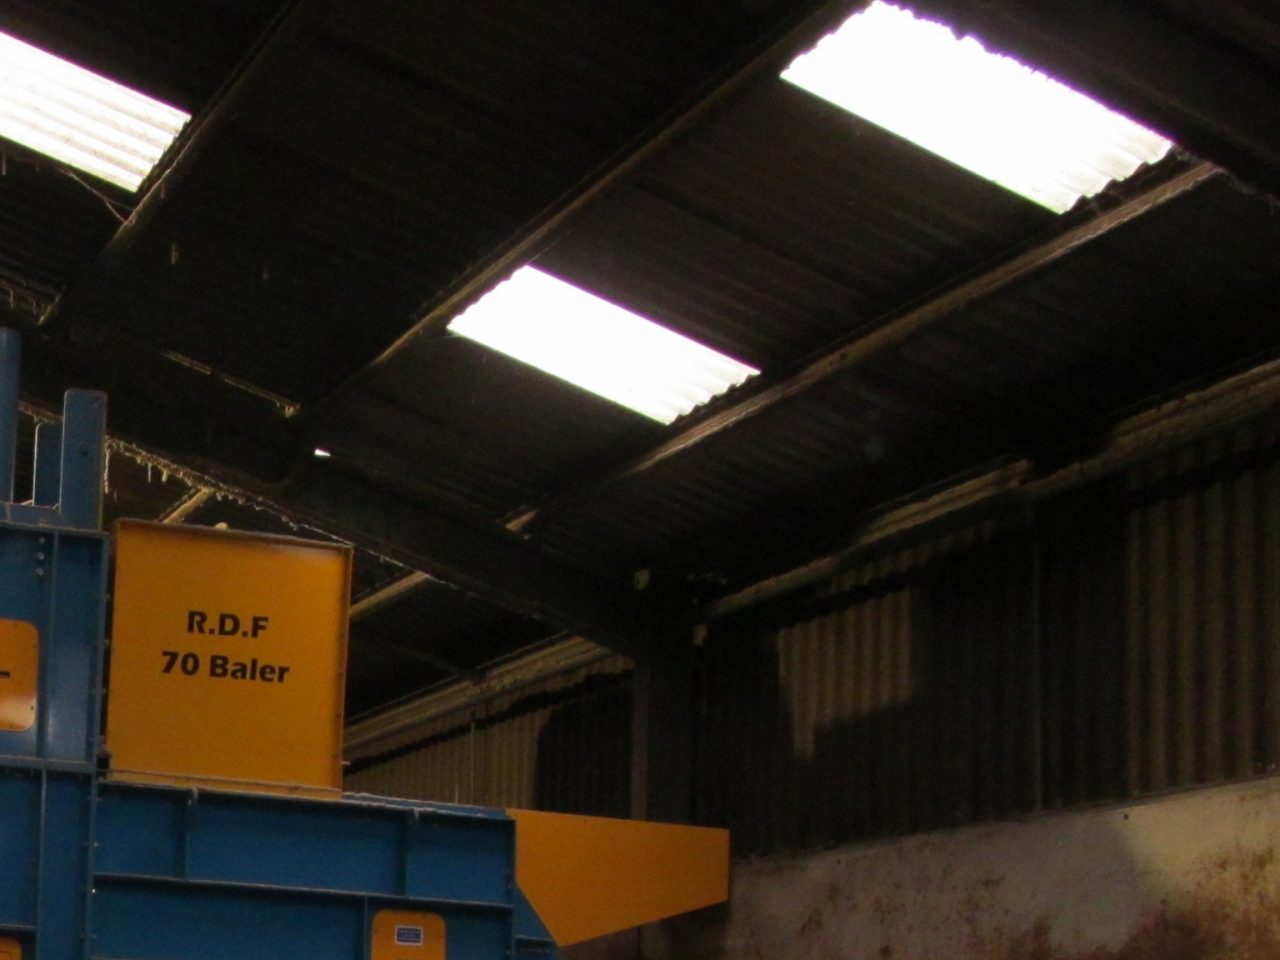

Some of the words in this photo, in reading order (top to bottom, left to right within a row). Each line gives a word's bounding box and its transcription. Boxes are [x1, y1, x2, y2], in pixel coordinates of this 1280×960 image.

[187, 611, 269, 638] R.D.F
[161, 651, 200, 675] 70
[209, 655, 289, 683] Baler
